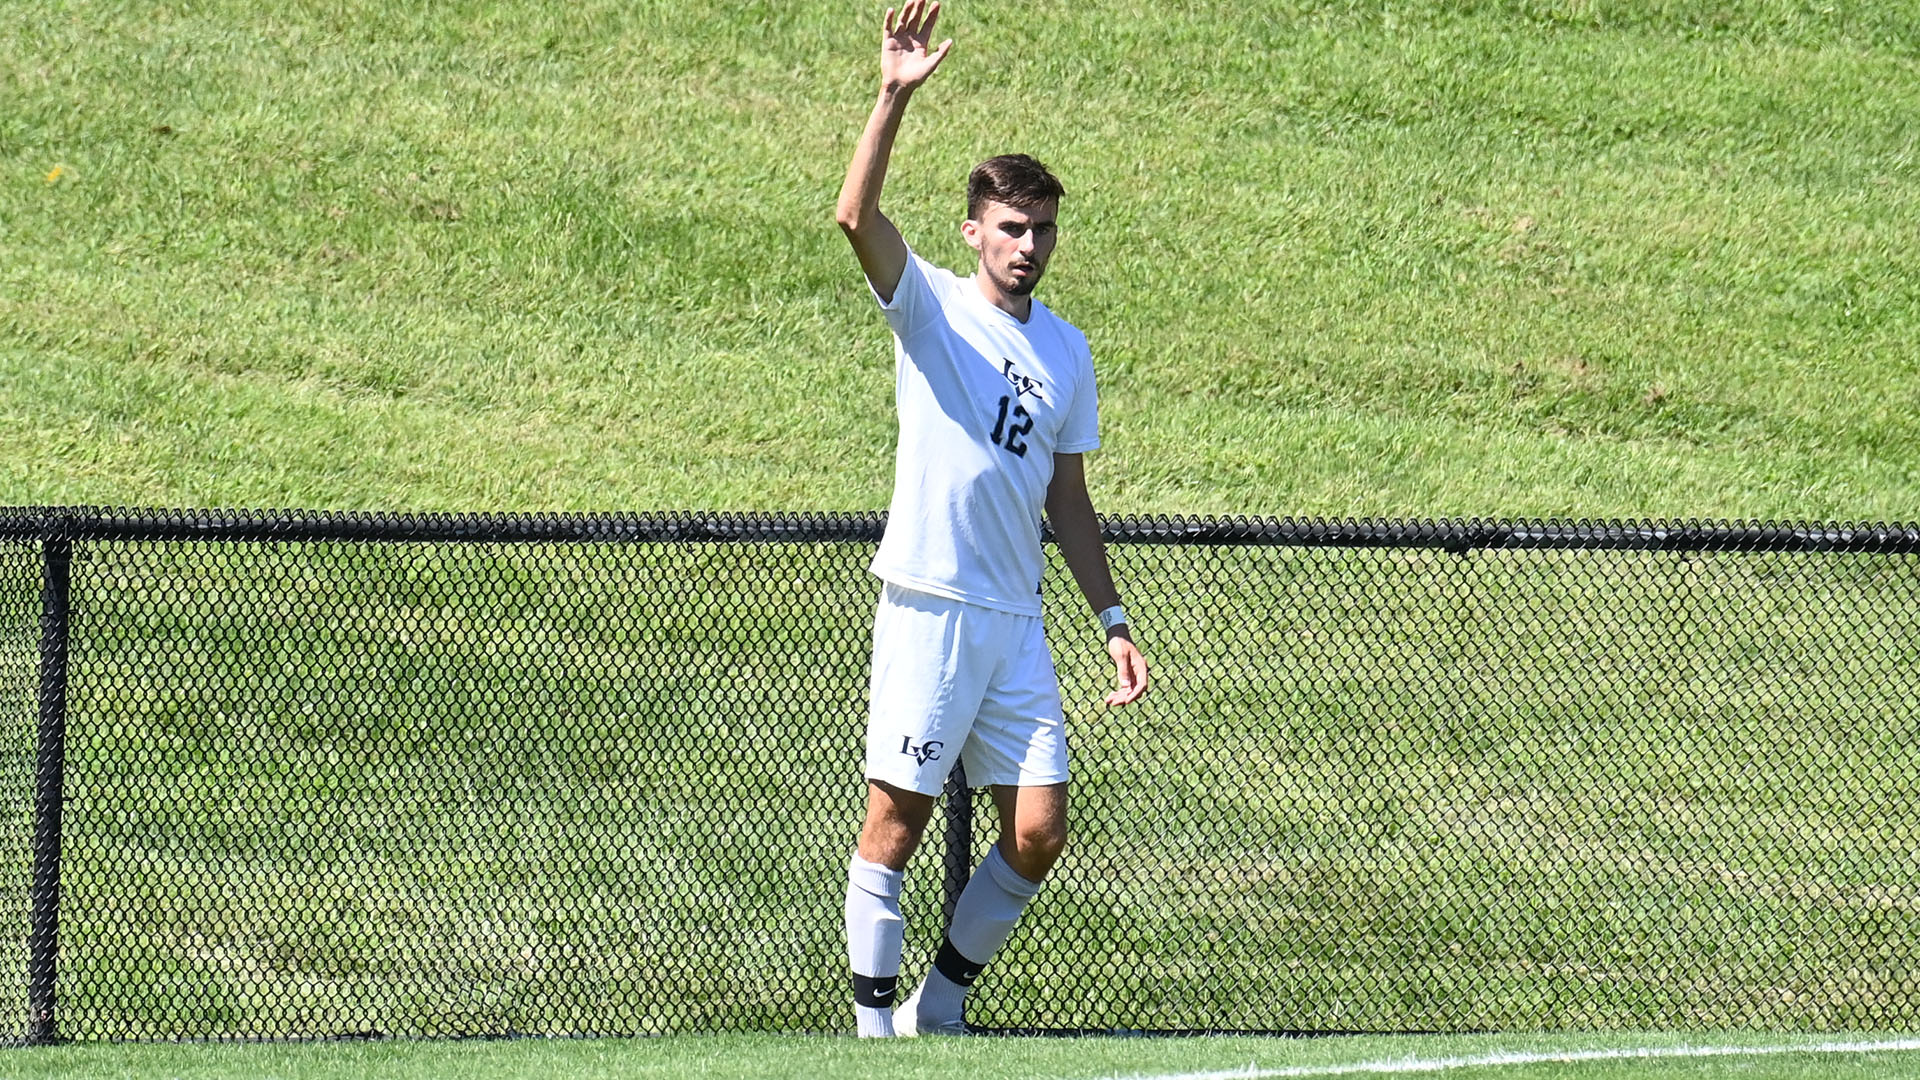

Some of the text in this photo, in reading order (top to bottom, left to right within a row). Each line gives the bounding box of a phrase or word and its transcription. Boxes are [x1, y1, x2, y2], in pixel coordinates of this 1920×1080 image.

[1003, 357, 1043, 400] LVC
[990, 395, 1034, 459] 12
[899, 735, 944, 767] LVC
